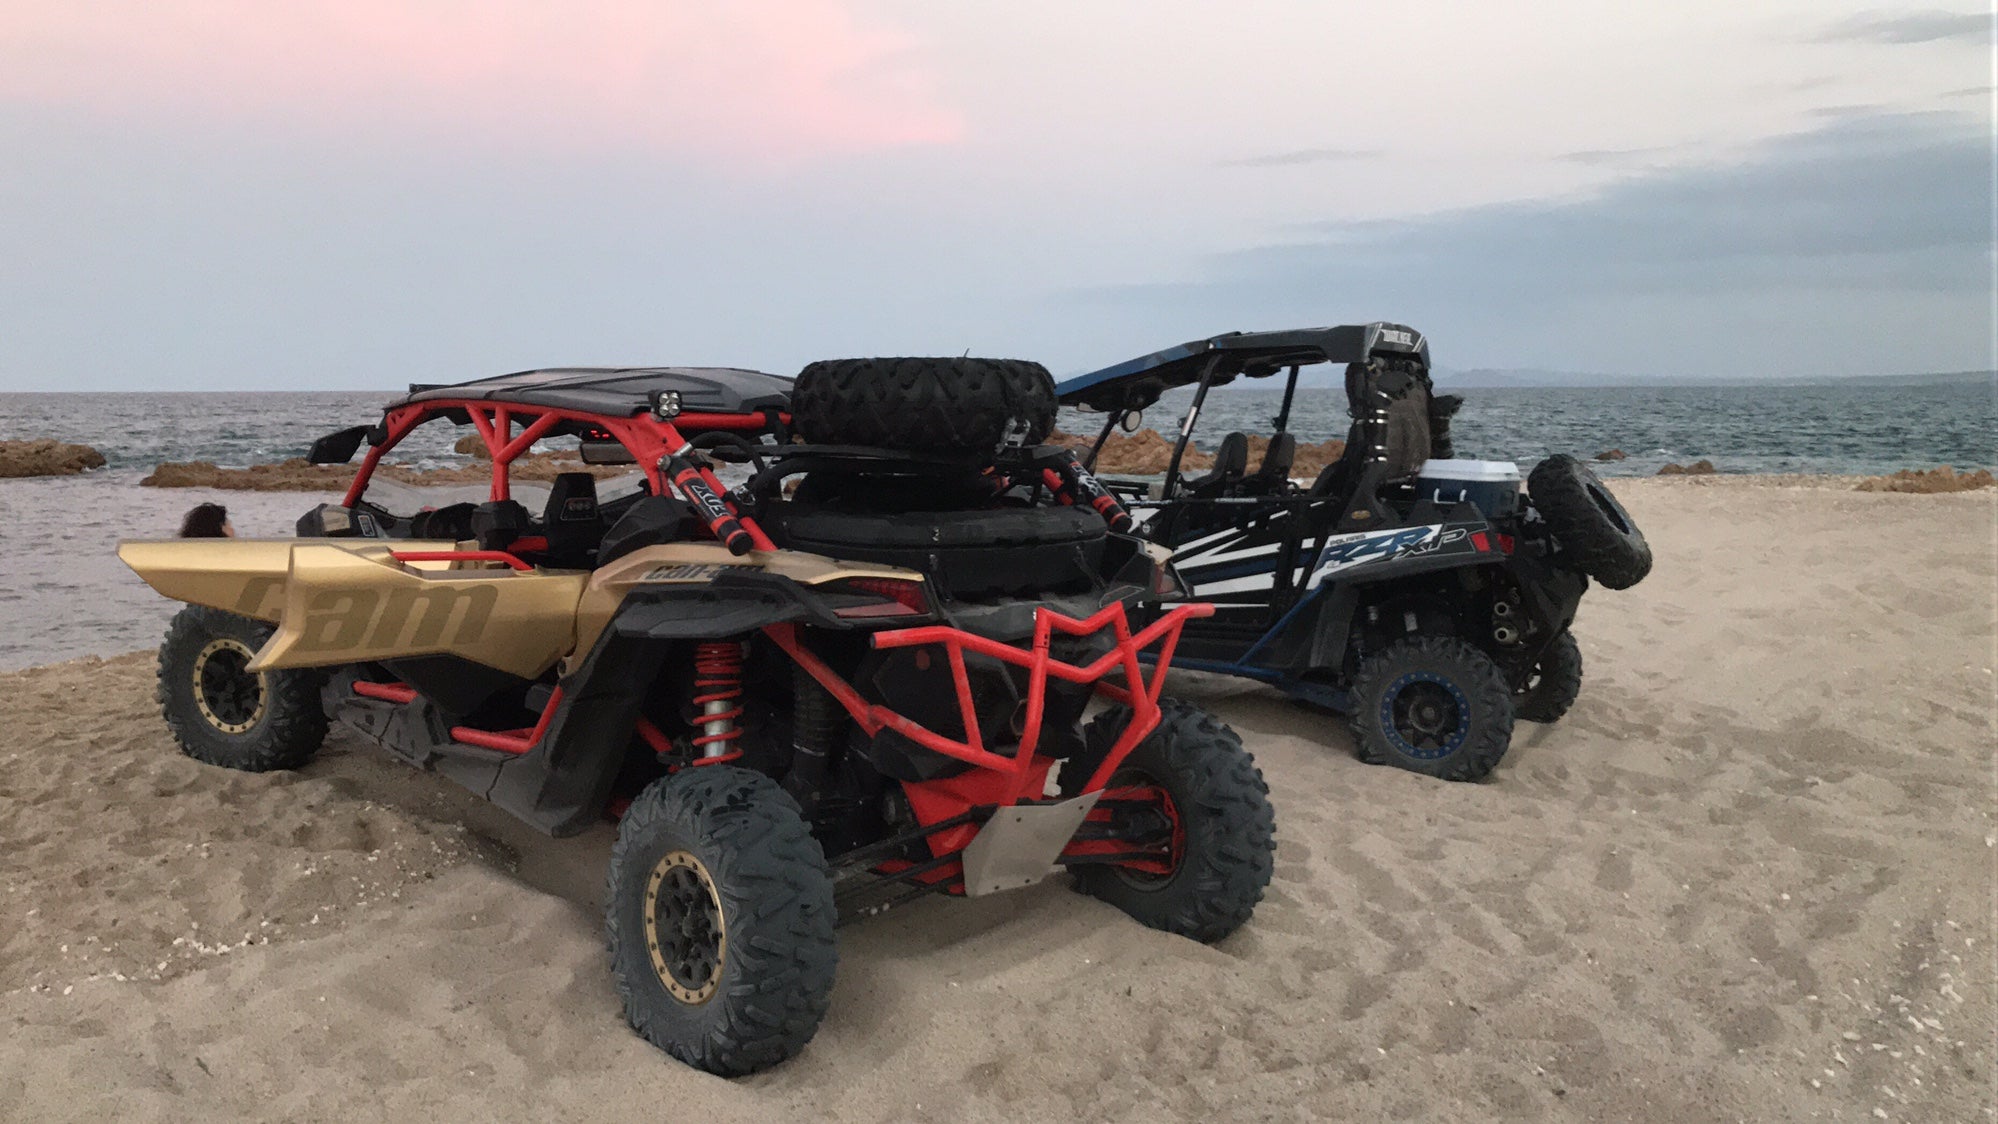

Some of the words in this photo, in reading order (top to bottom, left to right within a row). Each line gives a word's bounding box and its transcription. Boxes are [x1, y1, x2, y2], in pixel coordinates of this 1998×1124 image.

[691, 484, 733, 517] FOX
[1313, 526, 1432, 571] RZR
[1392, 528, 1467, 560] XP
[1329, 534, 1366, 546] POLARIS
